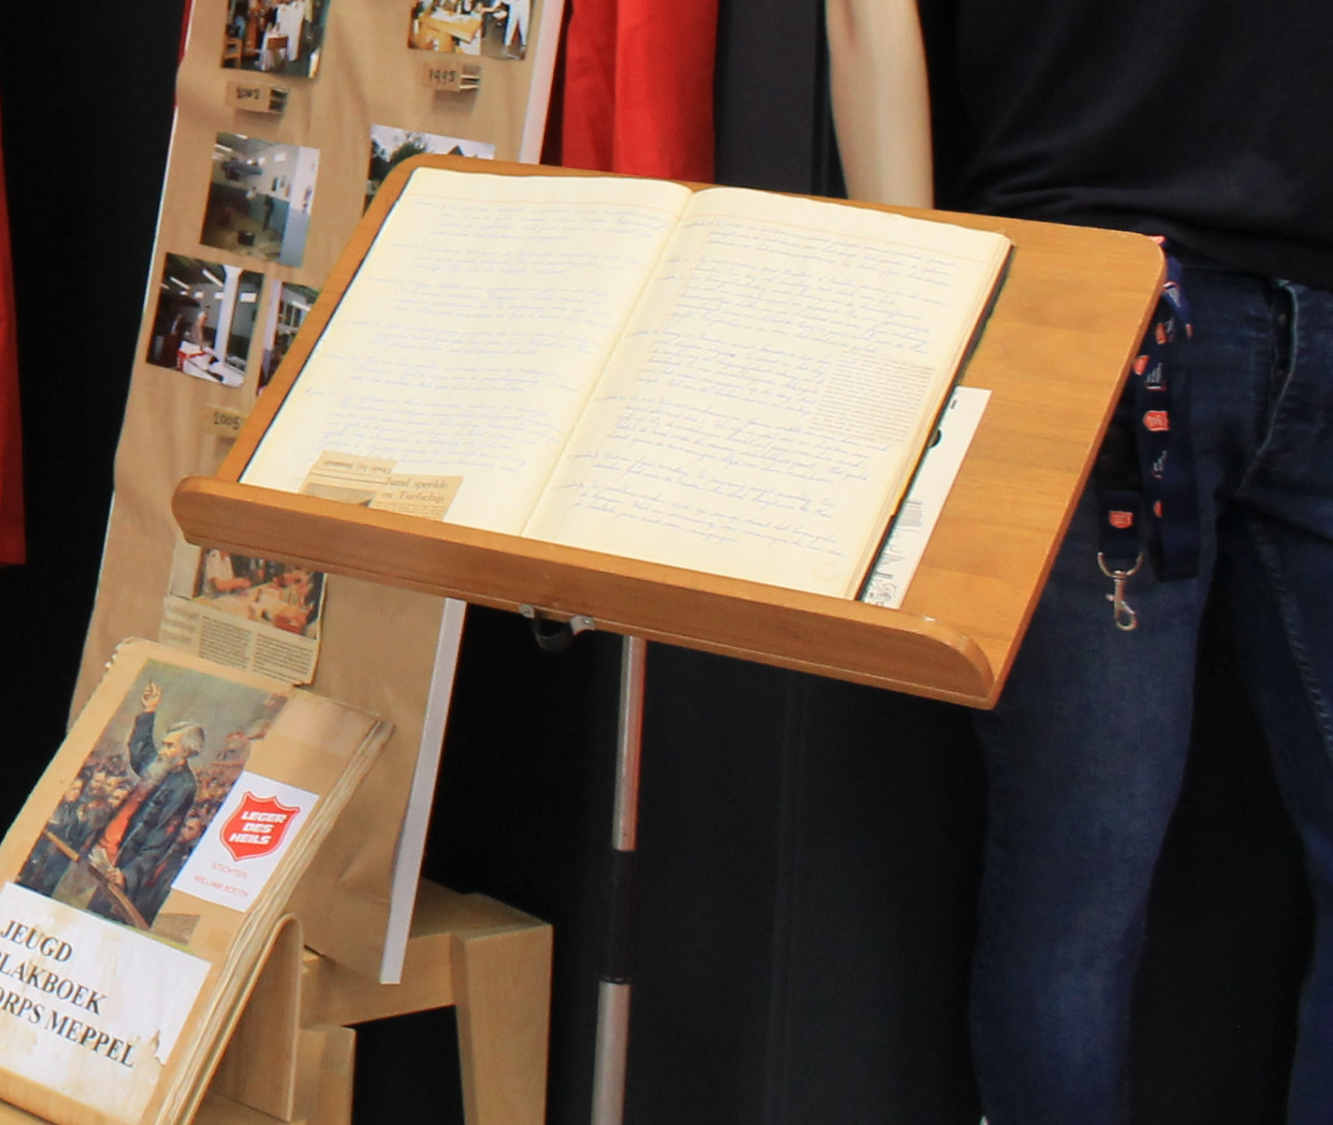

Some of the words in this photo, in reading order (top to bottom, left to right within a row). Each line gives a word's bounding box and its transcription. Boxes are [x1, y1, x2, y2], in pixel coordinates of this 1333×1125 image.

[241, 811, 286, 823] LEGER
[242, 822, 274, 833] DES
[229, 832, 272, 845] HEILS
[211, 862, 248, 880] STICHTER
[0, 919, 73, 962] JEUGD
[45, 1009, 134, 1068] MEPPEL
